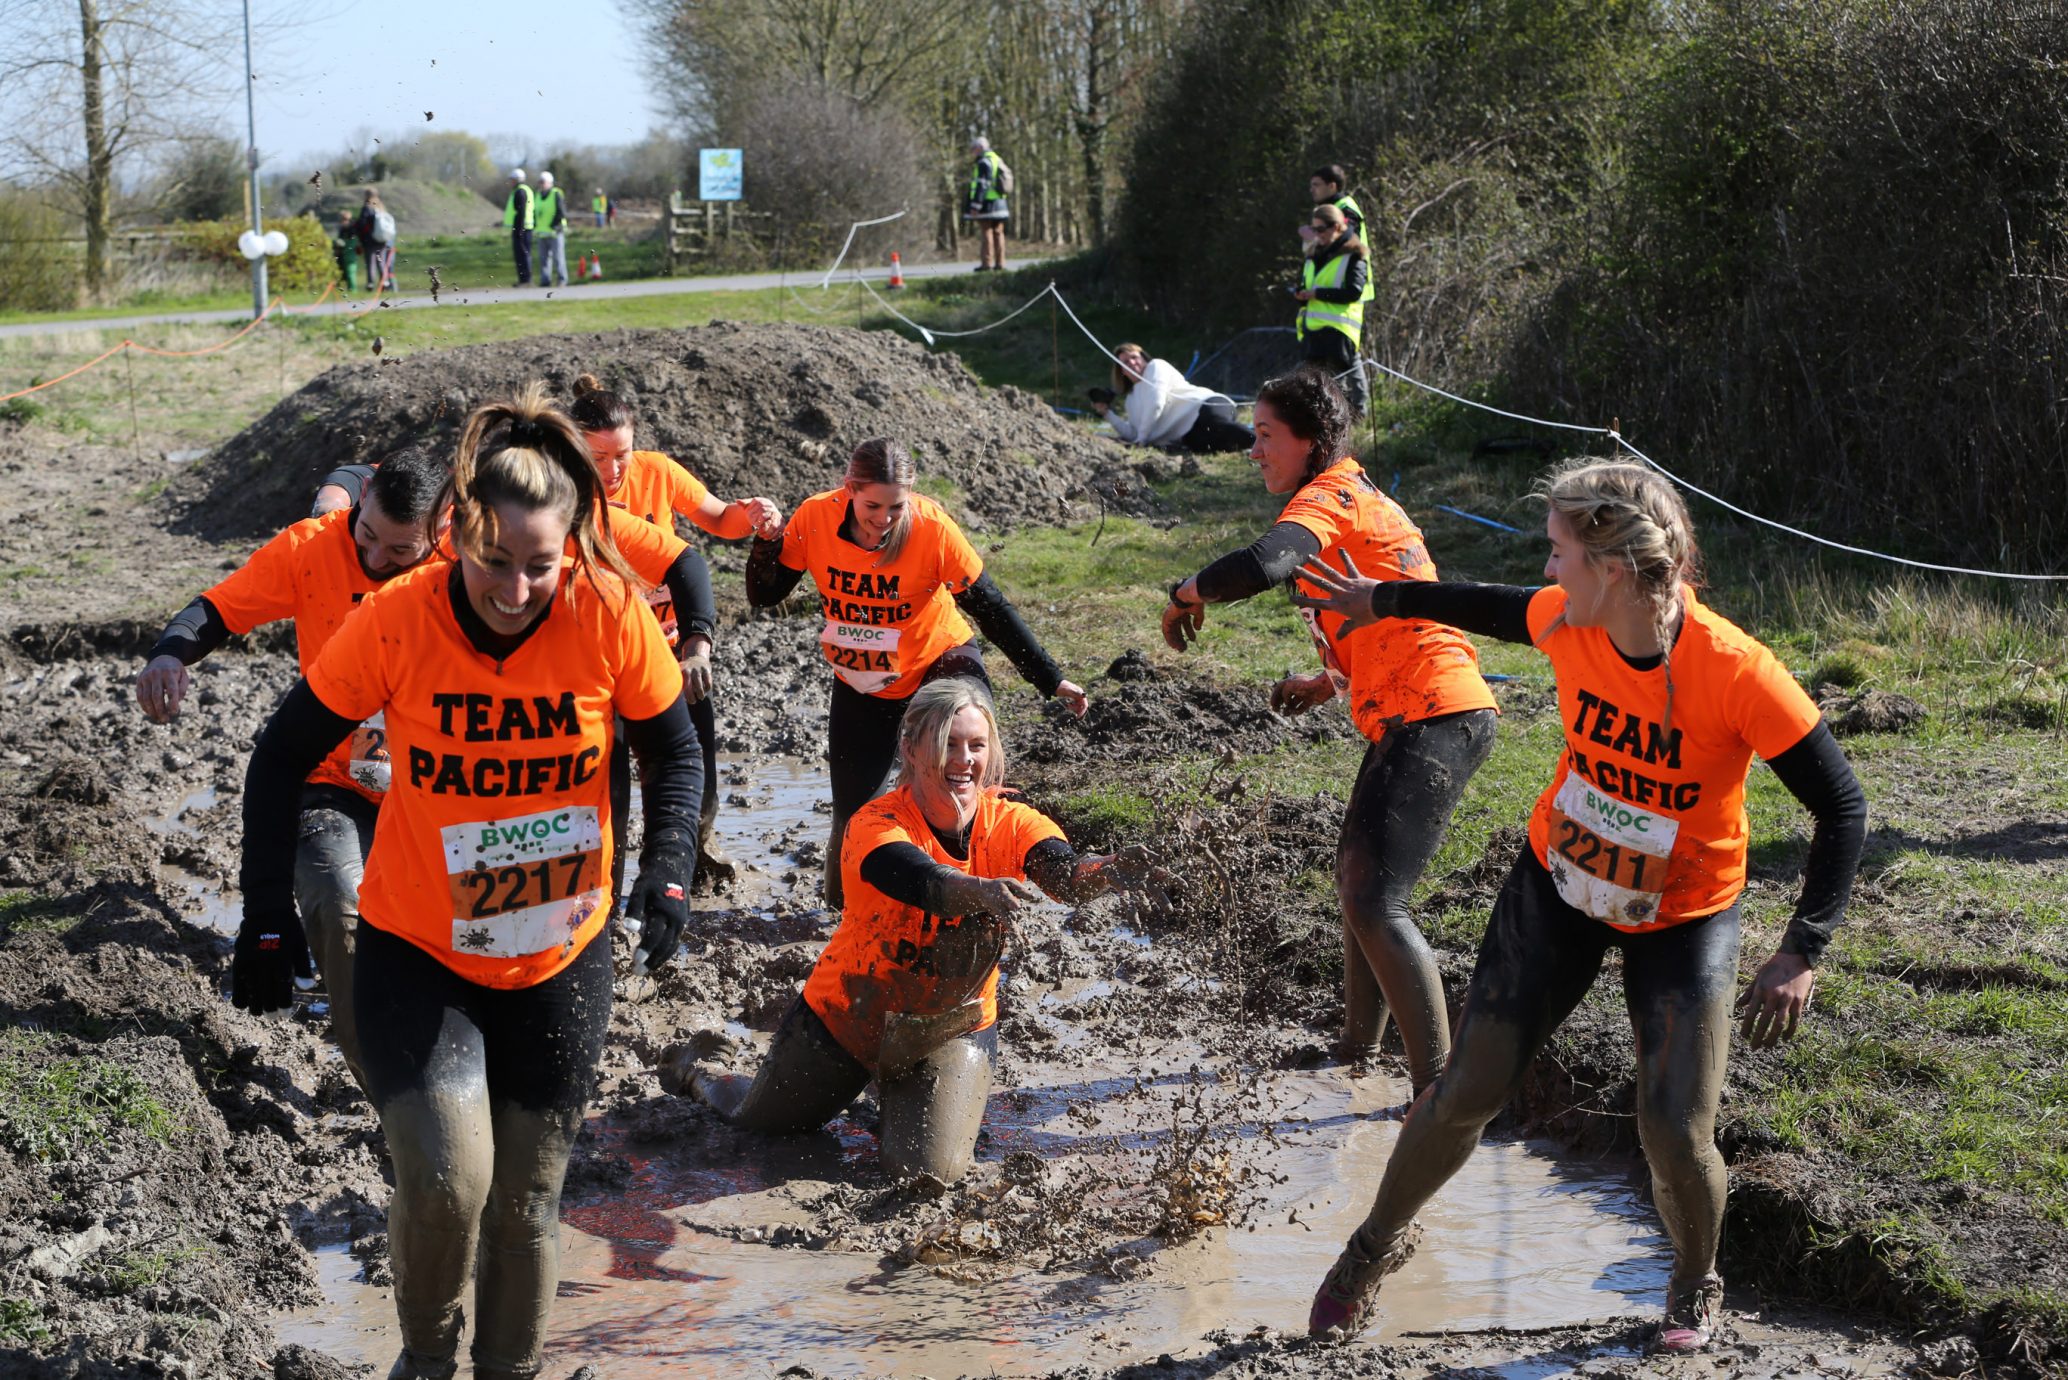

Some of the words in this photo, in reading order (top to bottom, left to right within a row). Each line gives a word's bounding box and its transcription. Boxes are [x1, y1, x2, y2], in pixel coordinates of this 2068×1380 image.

[827, 566, 900, 600] TEAM
[831, 645, 891, 671] 2214
[837, 626, 885, 641] BWOC
[433, 691, 582, 742] TEAM
[1573, 688, 1683, 769] TEAM
[409, 745, 600, 797] PACIFIC
[1568, 744, 1702, 812] ACIFIC
[481, 814, 570, 847] BWOC
[1586, 790, 1652, 833] BWOC
[1561, 819, 1646, 889] 2211
[469, 854, 587, 918] 2217
